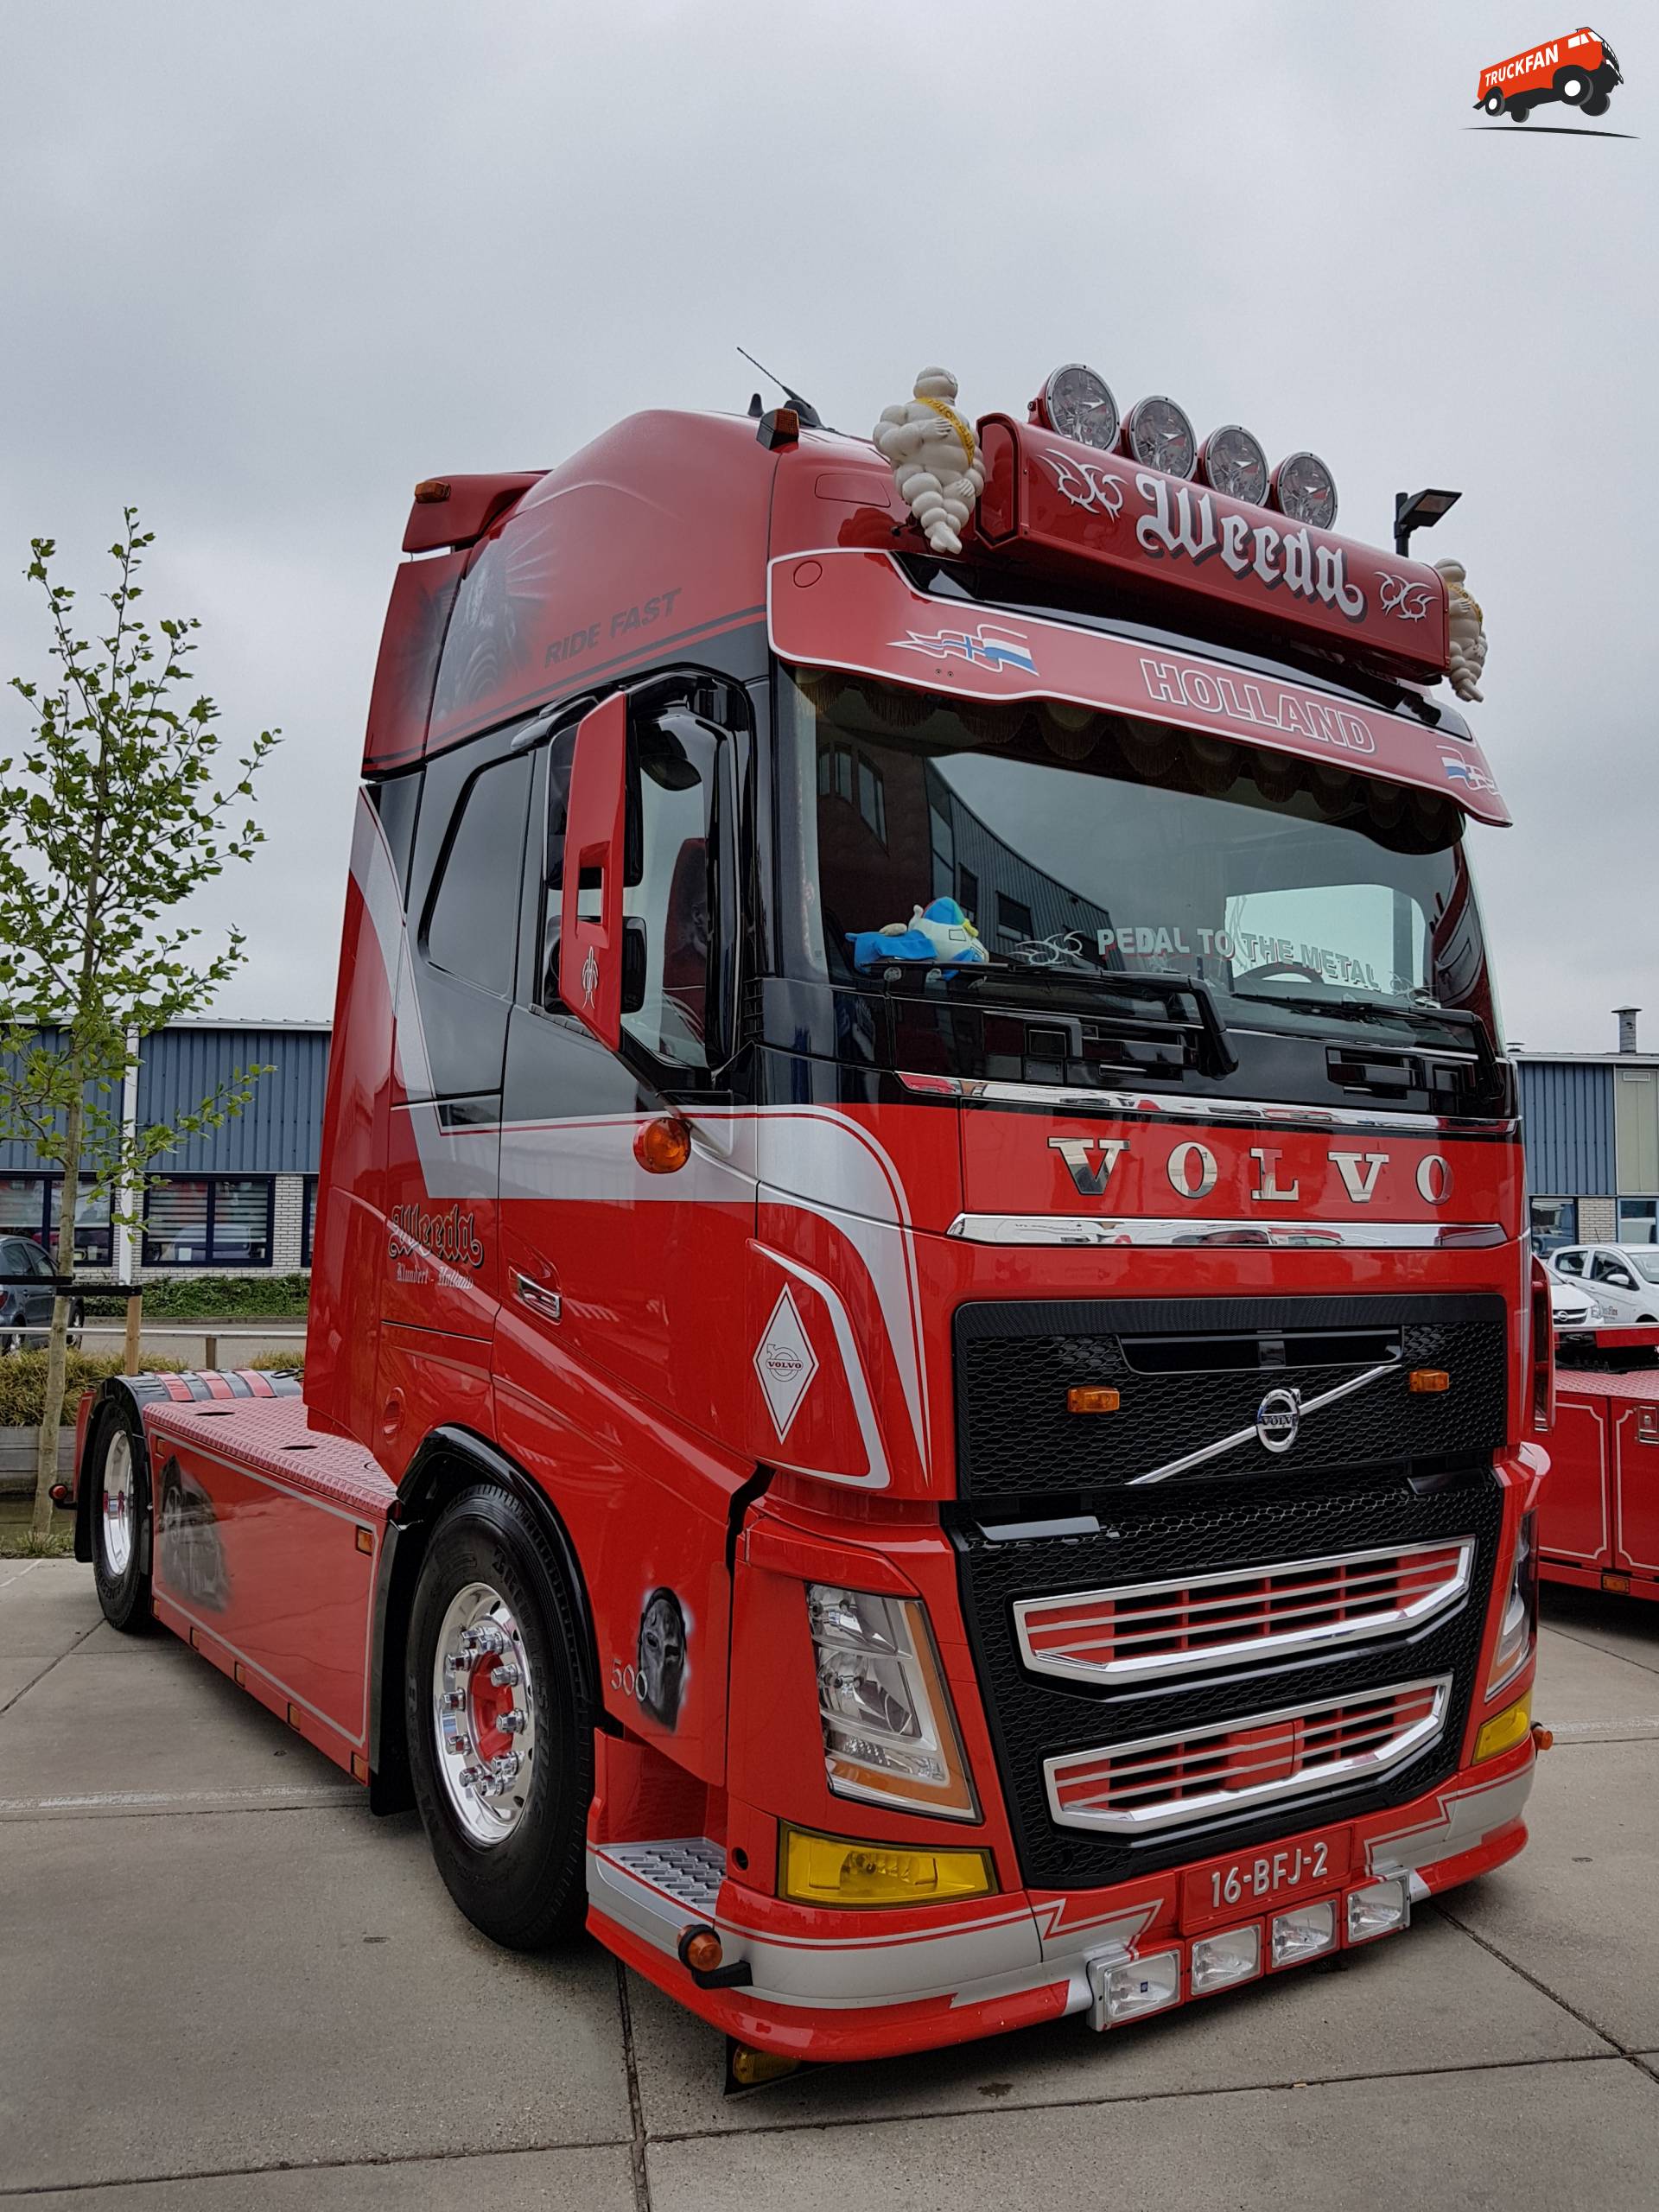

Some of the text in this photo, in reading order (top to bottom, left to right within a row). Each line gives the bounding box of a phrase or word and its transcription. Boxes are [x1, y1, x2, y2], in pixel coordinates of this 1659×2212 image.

[1135, 473, 1366, 619] Weeda
[544, 587, 683, 670] RIDE FAST
[1140, 658, 1376, 753] HOLLAND
[1096, 926, 1382, 992] PEDAL TO THE METAL
[1047, 1136, 1455, 1205] VOLVO
[389, 1203, 484, 1268] Weeda
[767, 1361, 802, 1370] VOLVO
[611, 1657, 648, 1702] 500
[1211, 1841, 1329, 1908] 16-BFJ-2
